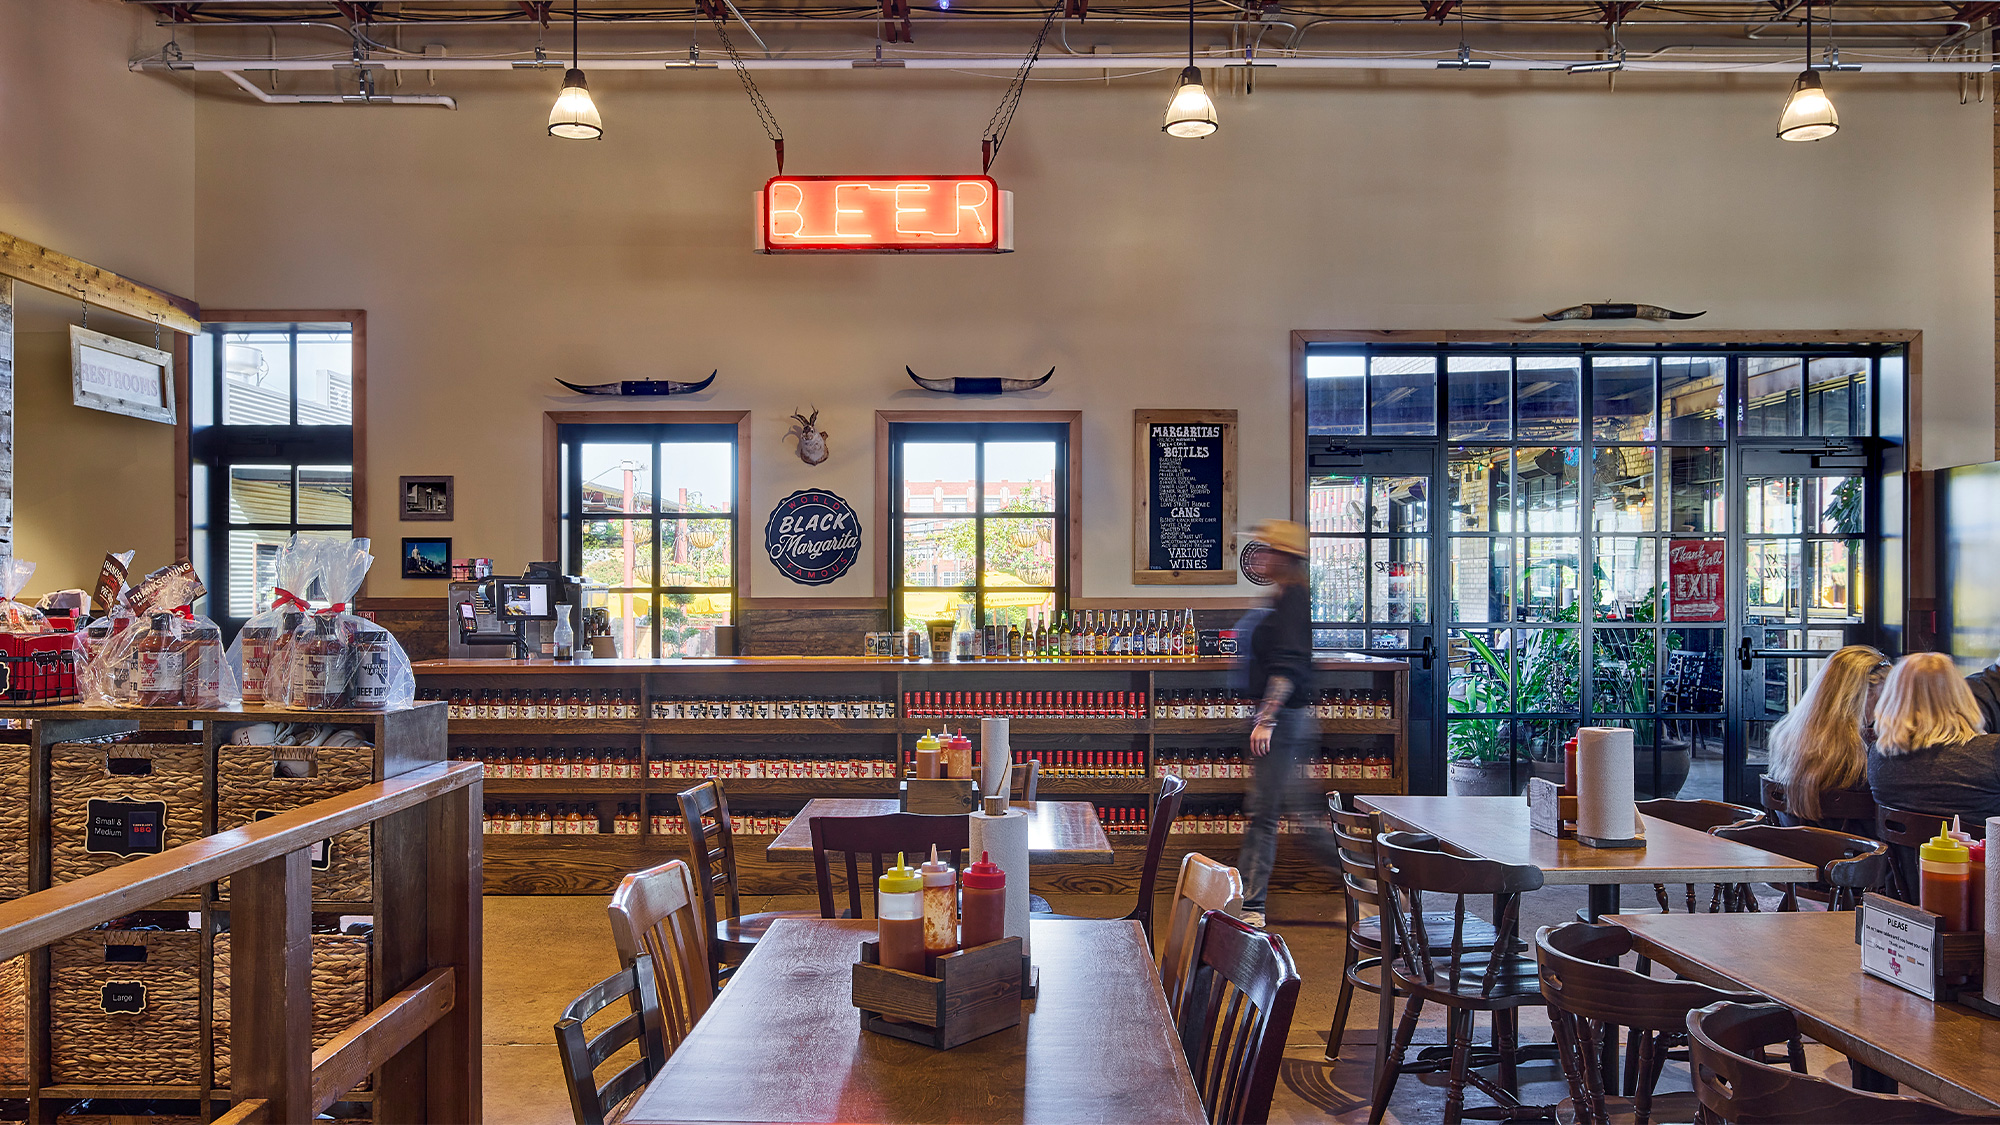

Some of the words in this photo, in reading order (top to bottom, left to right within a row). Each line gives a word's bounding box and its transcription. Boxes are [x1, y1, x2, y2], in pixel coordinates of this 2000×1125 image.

[771, 181, 988, 239] BEER
[80, 363, 158, 397] RESTROOMS
[1152, 426, 1220, 438] MARGARITAS
[1164, 446, 1210, 458] BOTTLES
[788, 495, 841, 510] WORLD
[1170, 507, 1200, 518] CANS
[779, 513, 850, 534] BLACK
[770, 529, 858, 559] Margarita
[1168, 548, 1208, 558] VARIOUS
[1670, 544, 1706, 564] Thank
[786, 557, 848, 579] FAMOUS
[1169, 559, 1208, 569] WINES
[130, 562, 191, 604] THANKSGIVING
[1674, 573, 1720, 601] EXIT
[357, 687, 373, 696] BEEF
[95, 817, 115, 825] Small
[94, 828, 122, 836] Medium
[1887, 918, 1908, 932] PLEASE
[113, 994, 132, 1002] Large
